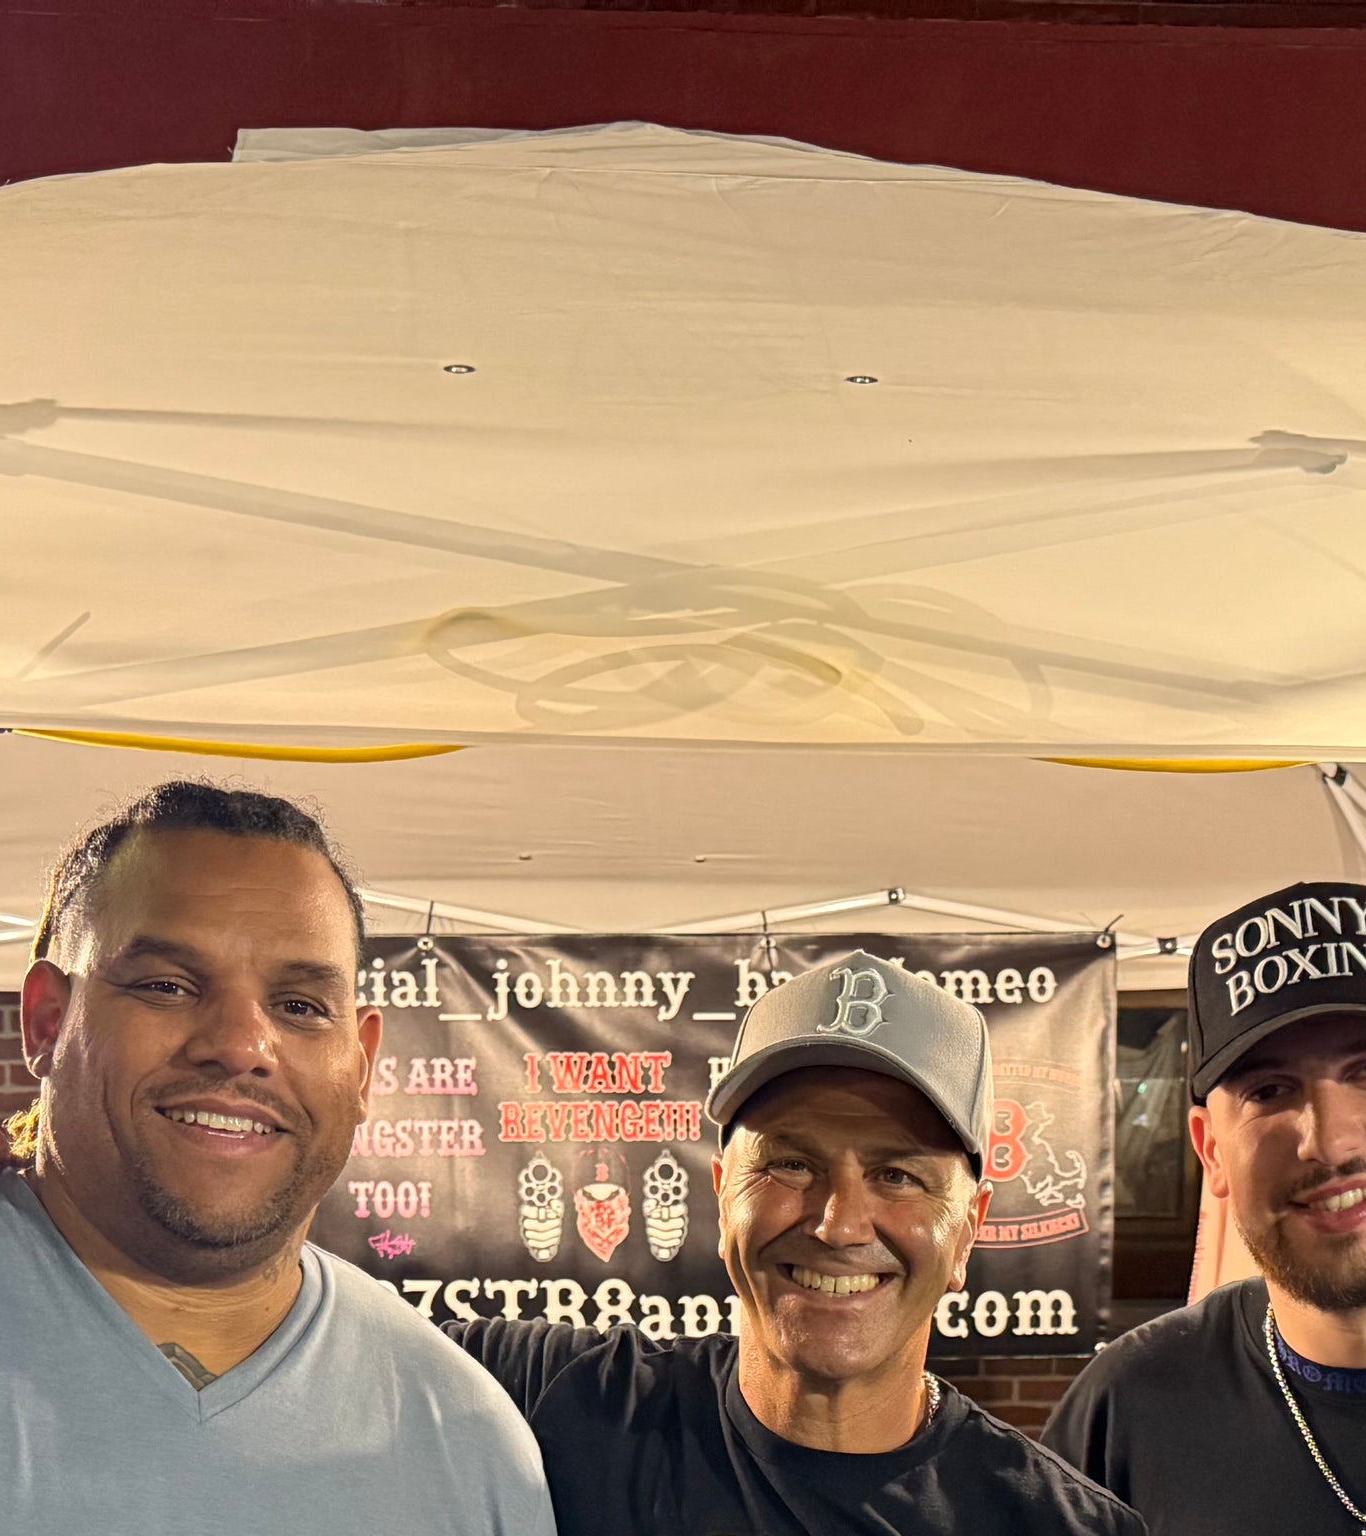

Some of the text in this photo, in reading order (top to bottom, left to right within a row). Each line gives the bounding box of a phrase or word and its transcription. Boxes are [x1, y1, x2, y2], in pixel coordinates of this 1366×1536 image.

[816, 967, 895, 1037] B
[404, 1056, 479, 1097] ARE
[523, 1051, 542, 1094] I
[548, 1050, 673, 1096] WANT
[352, 1117, 487, 1158] NGSTER
[498, 1099, 702, 1144] REVENGE!!!
[349, 1180, 432, 1220] TOO!
